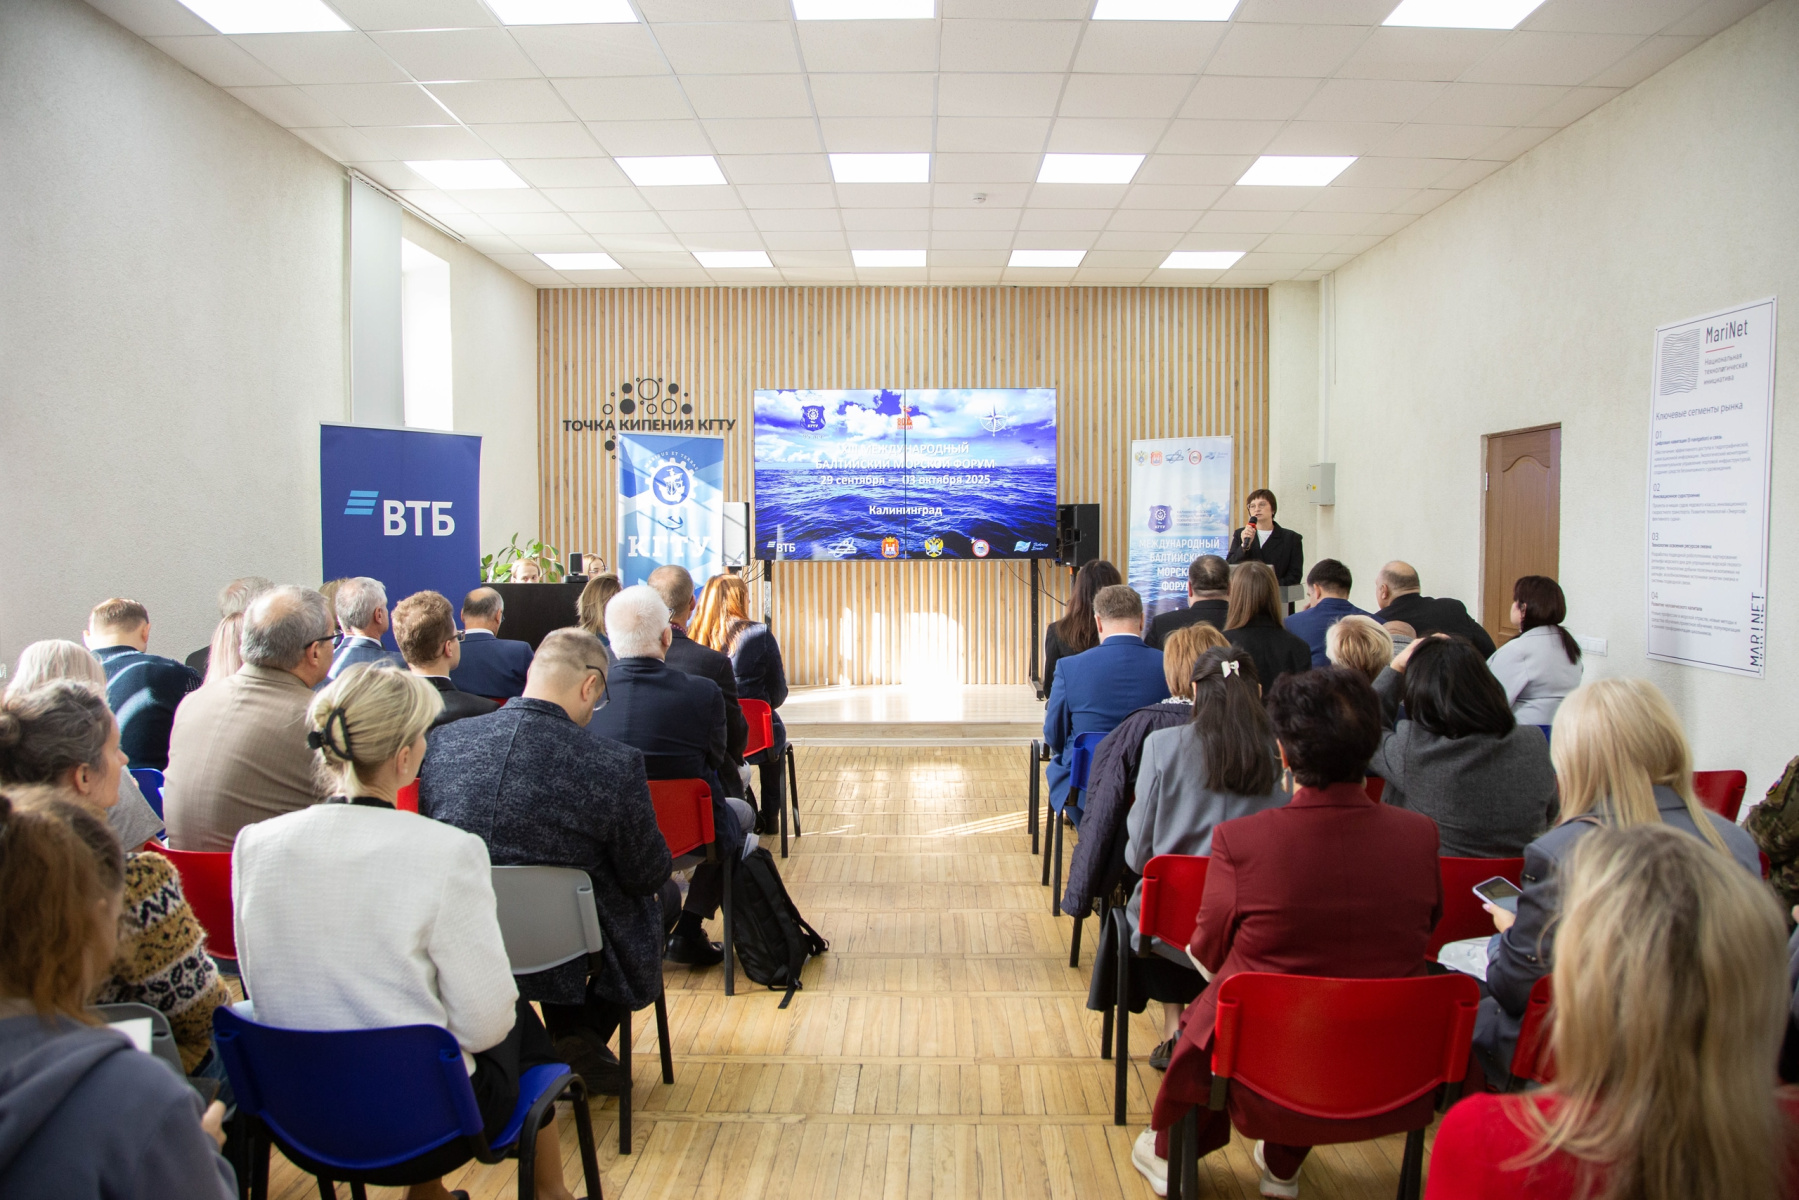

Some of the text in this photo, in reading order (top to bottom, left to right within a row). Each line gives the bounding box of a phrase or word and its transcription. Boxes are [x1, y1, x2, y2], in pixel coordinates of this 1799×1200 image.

[1705, 319, 1748, 344] MariNet
[1704, 353, 1742, 366] Национальная
[1703, 374, 1735, 385] инициатива
[1655, 402, 1743, 421] Ключевые сегменты рынка
[562, 418, 736, 432] ТОЧКА КИПЕНИЯ КГТУ
[1655, 430, 1662, 439] 01
[860, 441, 969, 455] МЕЖДУНАРОДНЫЙ
[815, 458, 996, 469] БАЛТИЙСКИЙ МОРСКОЙ ФОРУМ
[820, 475, 833, 485] 29
[836, 475, 885, 487] сентября
[902, 475, 915, 485] 03
[918, 475, 962, 487] октября
[964, 474, 991, 485] 2025
[1653, 482, 1661, 492] 02
[869, 505, 943, 518] Калининград
[383, 500, 456, 537] ВТБ
[1139, 536, 1220, 549] МЕЖДУНАРОДНЫЙ
[1651, 532, 1659, 541] 03
[627, 535, 712, 558] КГТУ
[776, 542, 796, 553] ВТБ
[1150, 551, 1207, 563] БАЛТИЙСК
[1161, 580, 1190, 592] ФОРУ
[1750, 592, 1764, 667] MARINET
